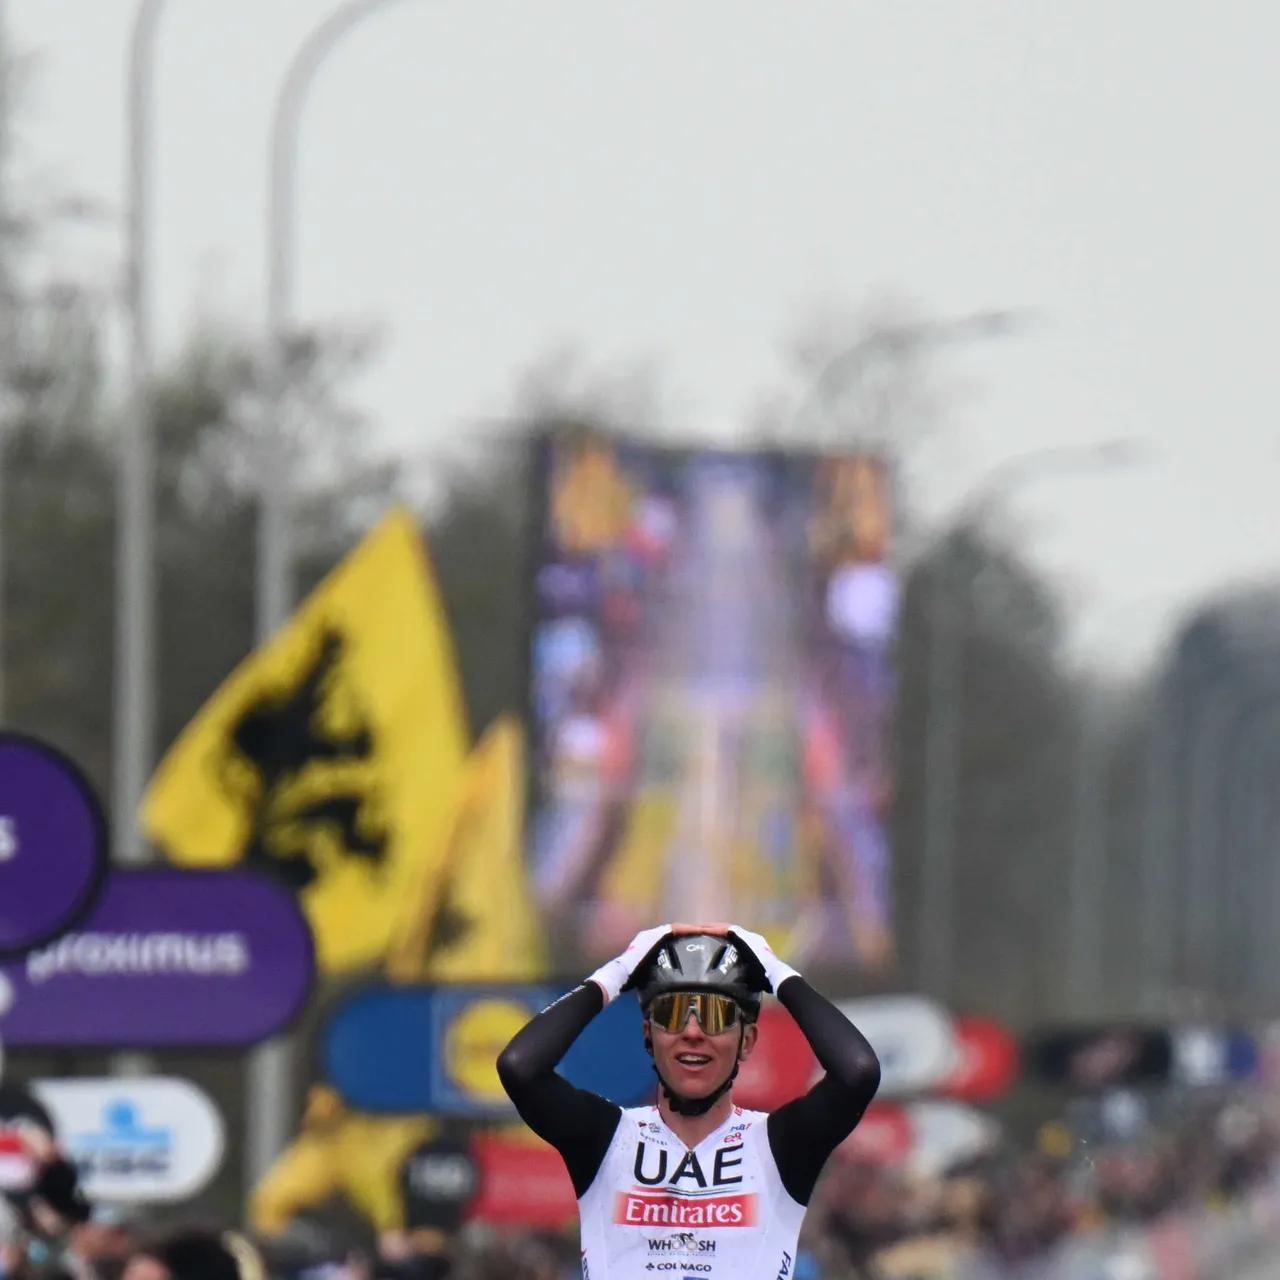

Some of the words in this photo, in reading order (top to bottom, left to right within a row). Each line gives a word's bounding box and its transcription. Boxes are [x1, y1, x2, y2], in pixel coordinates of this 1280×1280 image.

[634, 1141, 744, 1188] UAE
[626, 1198, 743, 1224] Emirates
[648, 1239, 716, 1252] WHOOSH
